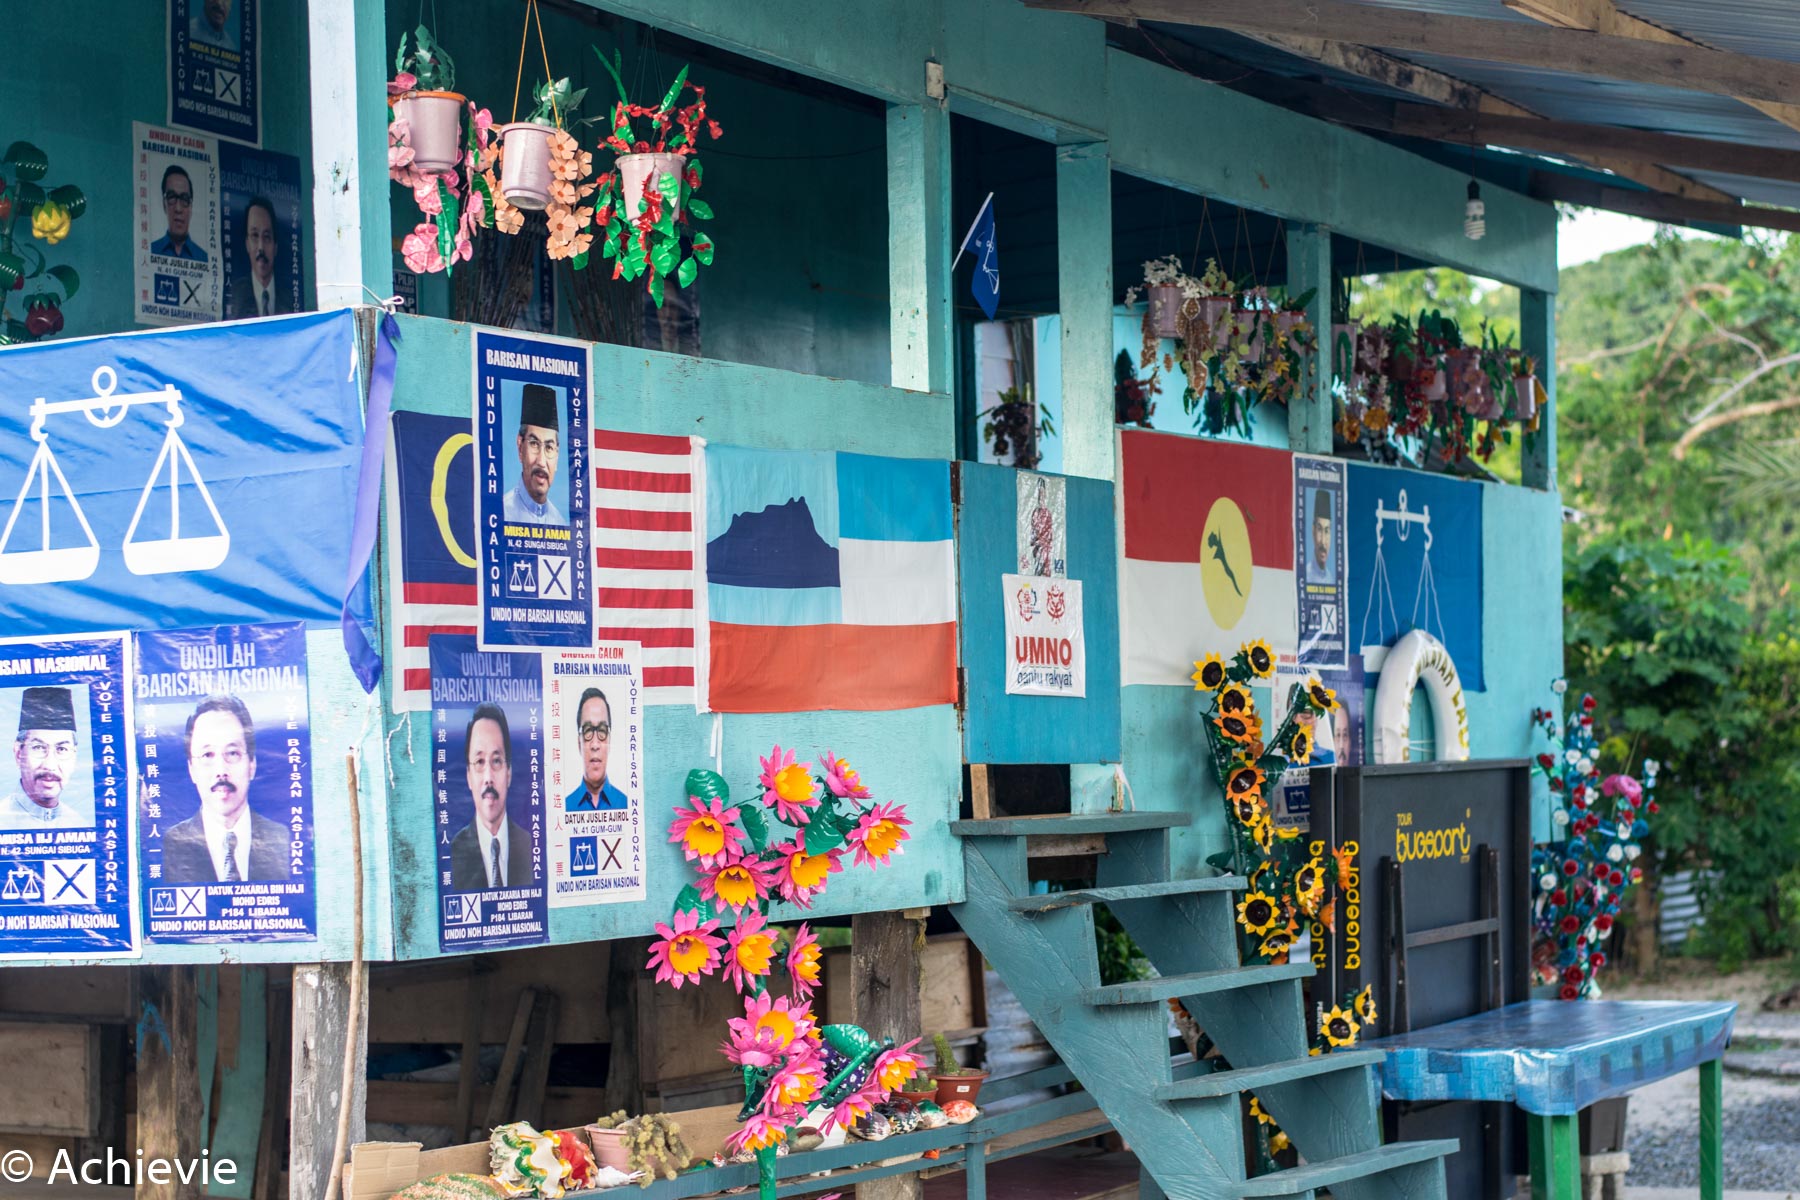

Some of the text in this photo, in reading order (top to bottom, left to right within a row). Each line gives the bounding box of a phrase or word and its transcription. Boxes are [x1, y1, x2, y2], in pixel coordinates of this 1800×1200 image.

[207, 105, 228, 119] BARISAN
[229, 111, 252, 126] NASIONAL
[150, 129, 205, 150] UNDILAH CALON
[142, 141, 211, 163] BARISAN NASIONAL
[220, 171, 300, 202] BARISAN NASIONAL
[151, 255, 169, 265] DATUK
[169, 259, 189, 269] JUSLIE
[171, 308, 192, 319] BARISAN
[486, 349, 580, 377] BARISAN NASIONAL
[486, 376, 500, 597] UNDILAH CALON
[572, 387, 585, 600] VOTE BARISAN NASIONAL
[504, 525, 571, 540] MUSA HJ AMAN
[524, 540, 546, 549] SUNGAI
[547, 541, 568, 551] SIBUGA
[491, 607, 586, 624] UNDIO NOH BARISAN NASIONAL
[180, 643, 256, 670] UNDILAH
[598, 647, 624, 659] CALON
[1016, 636, 1072, 666] UMNO
[0, 654, 110, 676] ISAN NASIONAL
[461, 652, 511, 676] UNDILAH
[554, 662, 632, 676] BARISAN NASIONAL
[137, 665, 304, 698] BARISAN NASIONAL
[1045, 669, 1073, 689] rakyat
[432, 678, 541, 702] BARISAN NASIONAL
[630, 725, 638, 788] BARISAN
[99, 681, 117, 902] VOTE BARISAN NASIONAL
[285, 695, 304, 875] VOTE BARISAN NASIONAL
[530, 708, 541, 879] VOTE BARISAN NASIONAL
[565, 811, 629, 825] DATUK JUSLIE AJIROL
[1397, 812, 1412, 826] TOUR
[0, 831, 96, 845] MUSA HJ AMAN
[590, 825, 622, 834] GUM-GUM
[631, 799, 640, 872] NASIONAL
[25, 846, 56, 854] SUNGAI
[58, 845, 91, 854] SIBUGA
[208, 883, 304, 896] DATUK ZAKARIA BIN HAJI
[556, 876, 640, 893] UNDIO NOH BARISAN NASIONAL
[232, 896, 280, 906] MOHD EDRIS
[481, 888, 542, 902] DATUK ZAKARIA BIN HAJI
[222, 907, 289, 917] P184 LIBARAN
[497, 901, 528, 912] MOHD EDRIS
[7, 916, 27, 930] NOH
[29, 915, 69, 929] BARISAN
[70, 914, 120, 929] NASIONAL
[151, 918, 306, 932] UNDIO NOH BARISAN NASIONAL
[490, 911, 533, 922] P184 LIBARAN
[444, 922, 543, 940] UNDIO NOH BARISAN NASIONAL
